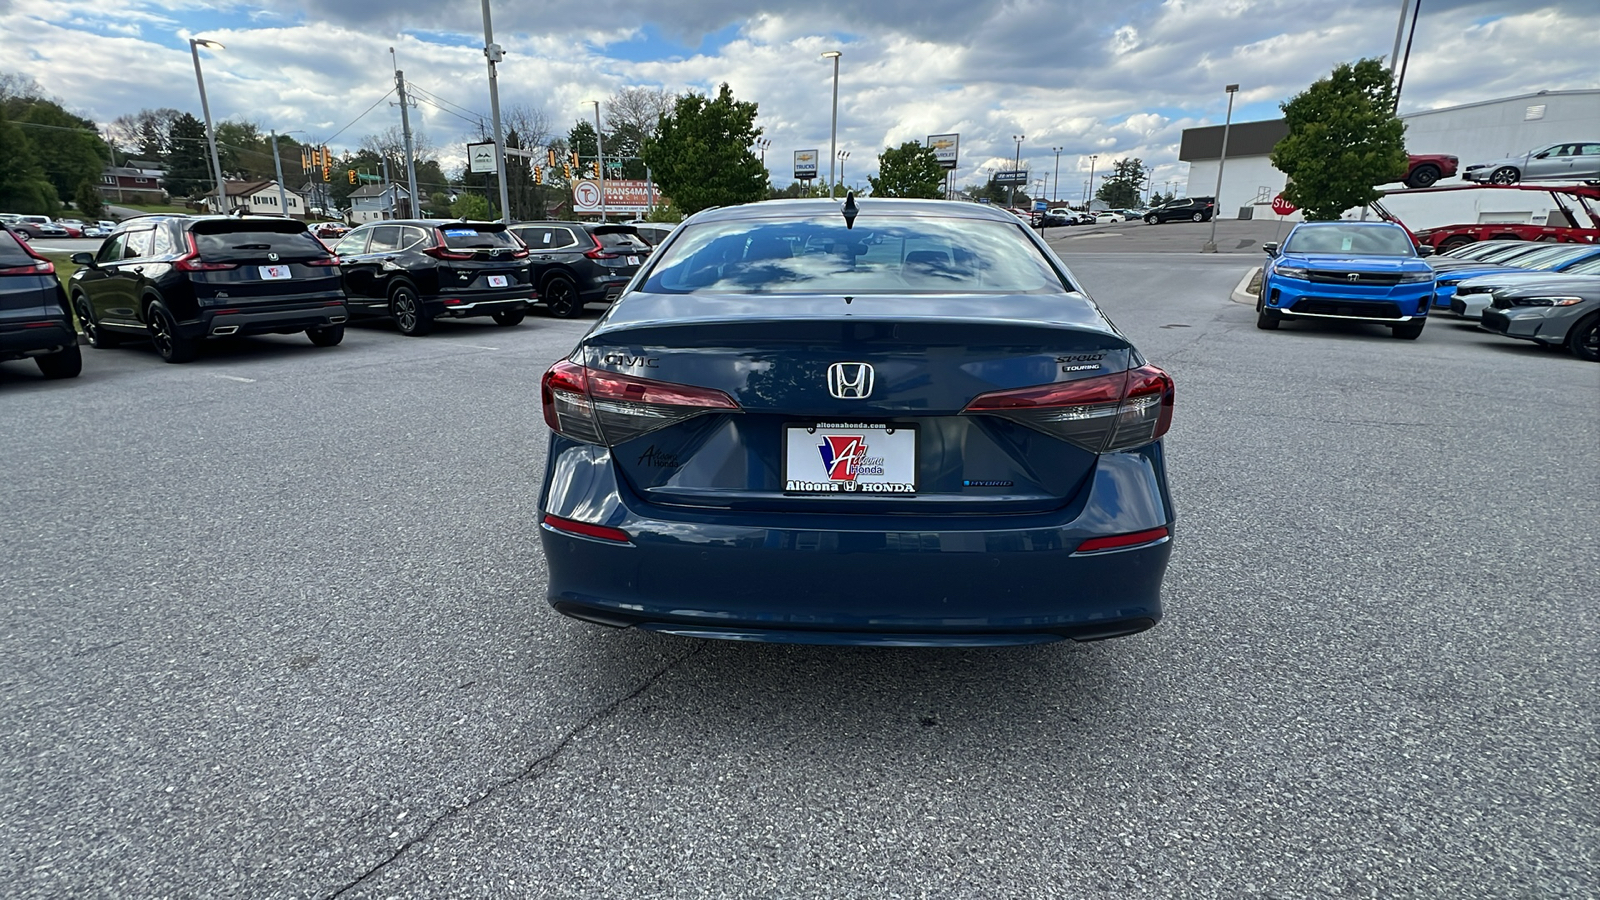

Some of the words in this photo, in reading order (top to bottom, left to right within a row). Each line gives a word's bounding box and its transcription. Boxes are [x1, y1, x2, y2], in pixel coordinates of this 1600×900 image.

[1274, 198, 1294, 209] STO
[604, 355, 659, 368] CIVIC
[1056, 354, 1107, 363] SPORT
[828, 440, 884, 475] Altoona
[851, 466, 883, 474] Honda
[786, 481, 839, 491] Altoona
[862, 483, 915, 492] HONDA
